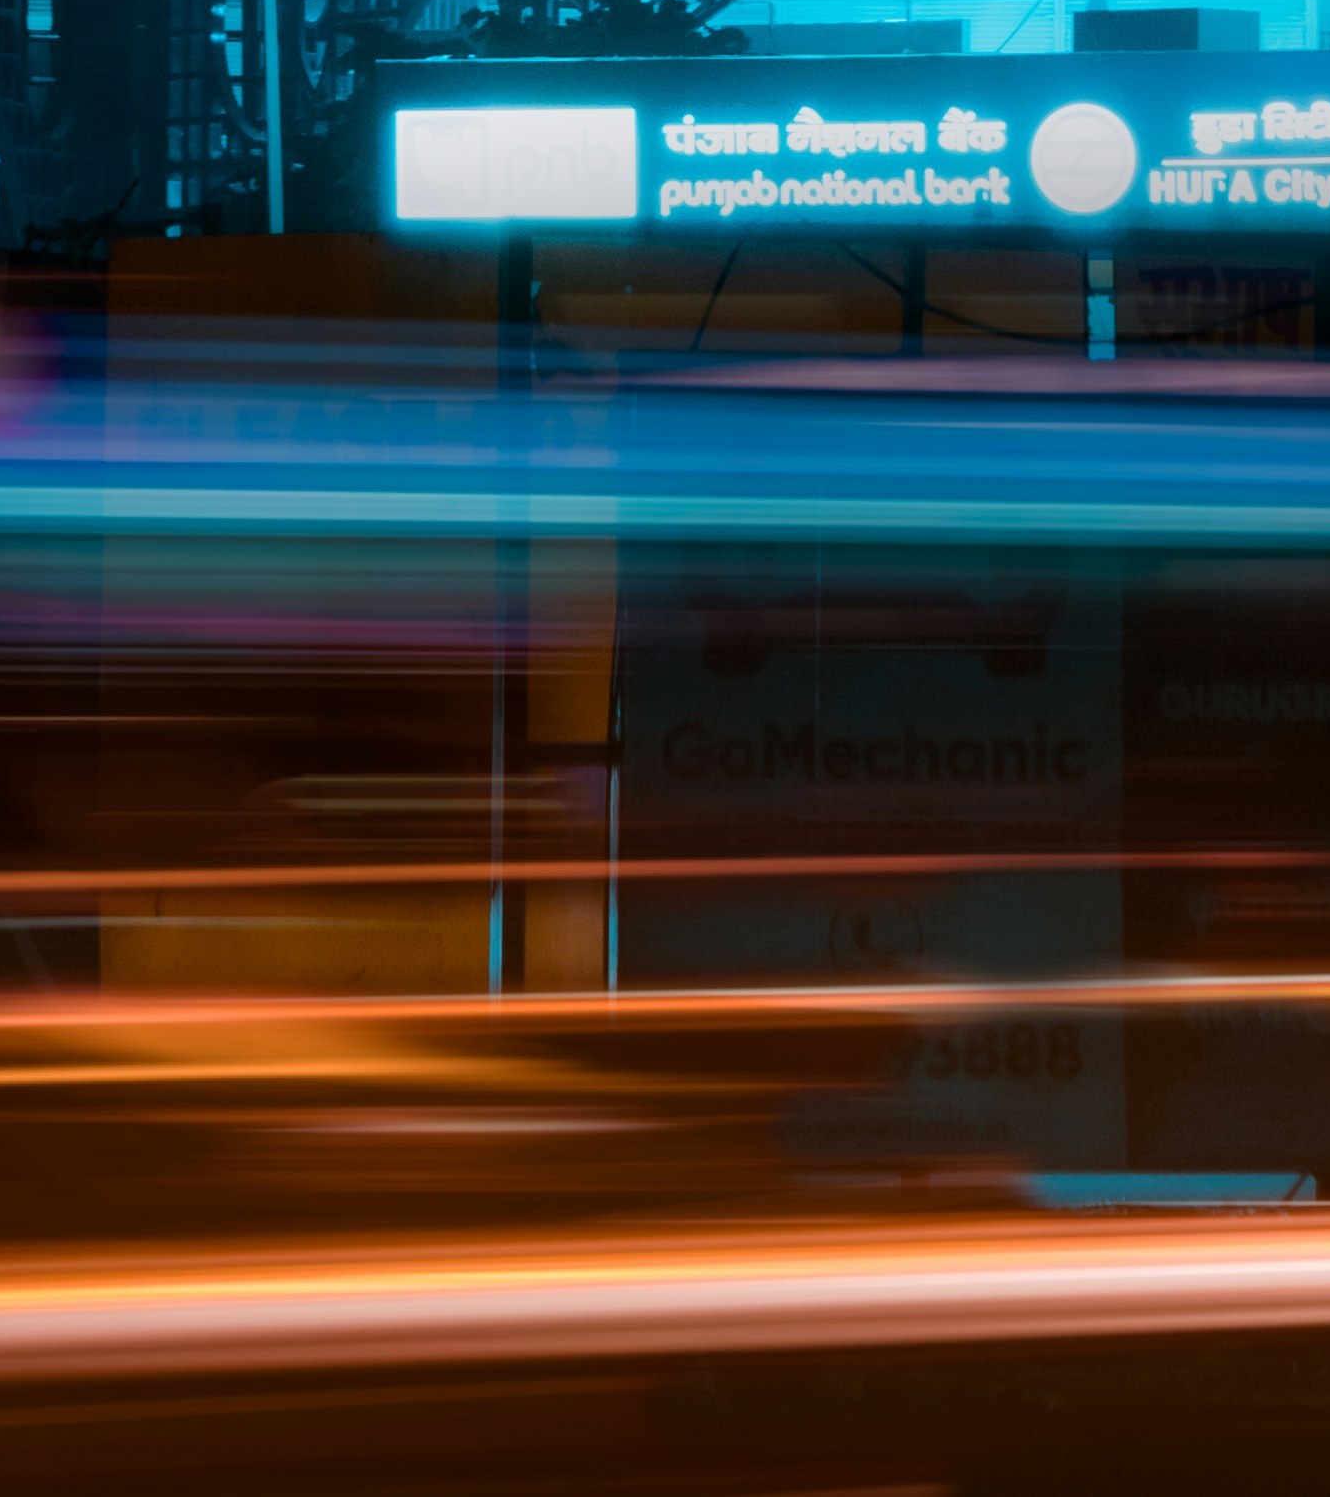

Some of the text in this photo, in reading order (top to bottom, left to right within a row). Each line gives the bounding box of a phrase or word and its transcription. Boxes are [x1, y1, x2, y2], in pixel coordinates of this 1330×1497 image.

[661, 114, 780, 155] पंजाब
[660, 168, 779, 217] punjab
[780, 168, 922, 206] national
[660, 719, 1089, 783] GoMechanic
